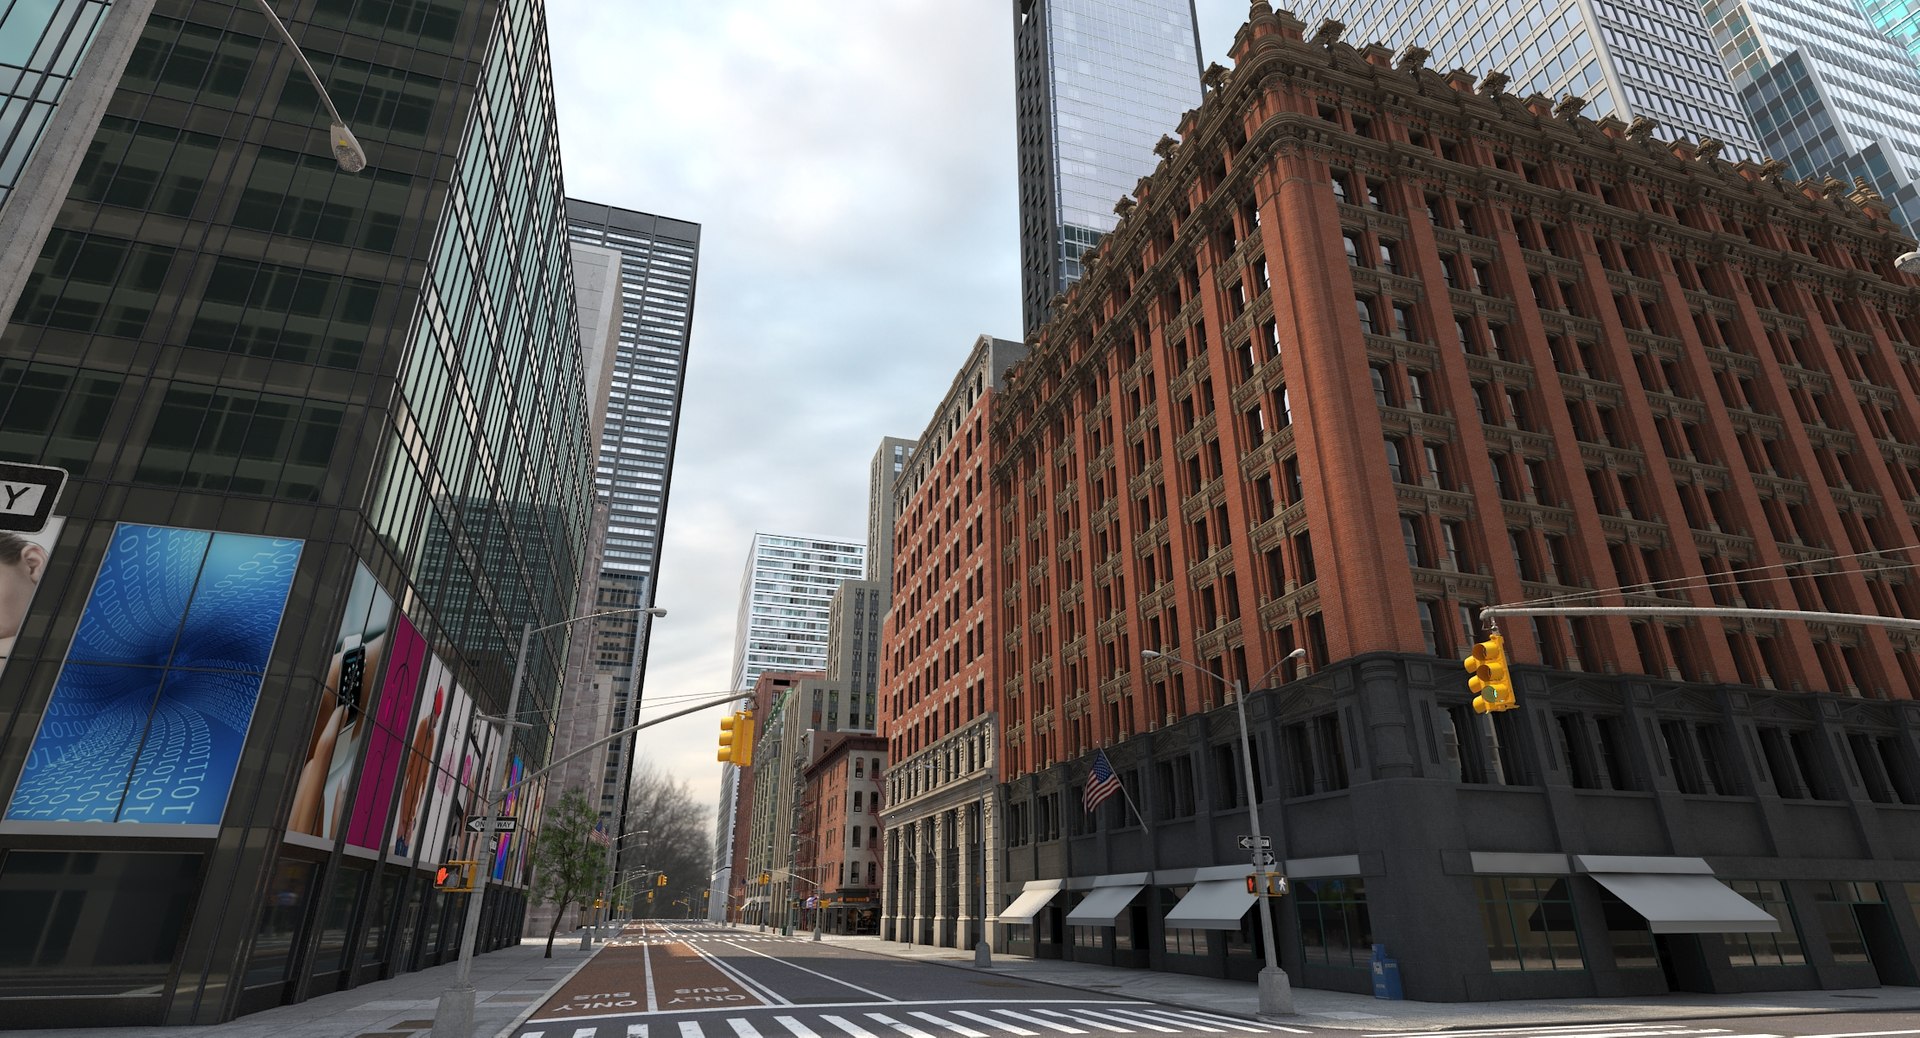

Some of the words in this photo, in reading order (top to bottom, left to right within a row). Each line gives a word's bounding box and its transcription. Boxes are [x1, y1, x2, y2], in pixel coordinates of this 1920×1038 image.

[474, 820, 486, 829] ON
[674, 986, 730, 995] BUS
[573, 991, 631, 1001] BUS
[668, 994, 746, 1004] ONLY
[553, 1000, 638, 1012] ONLY
